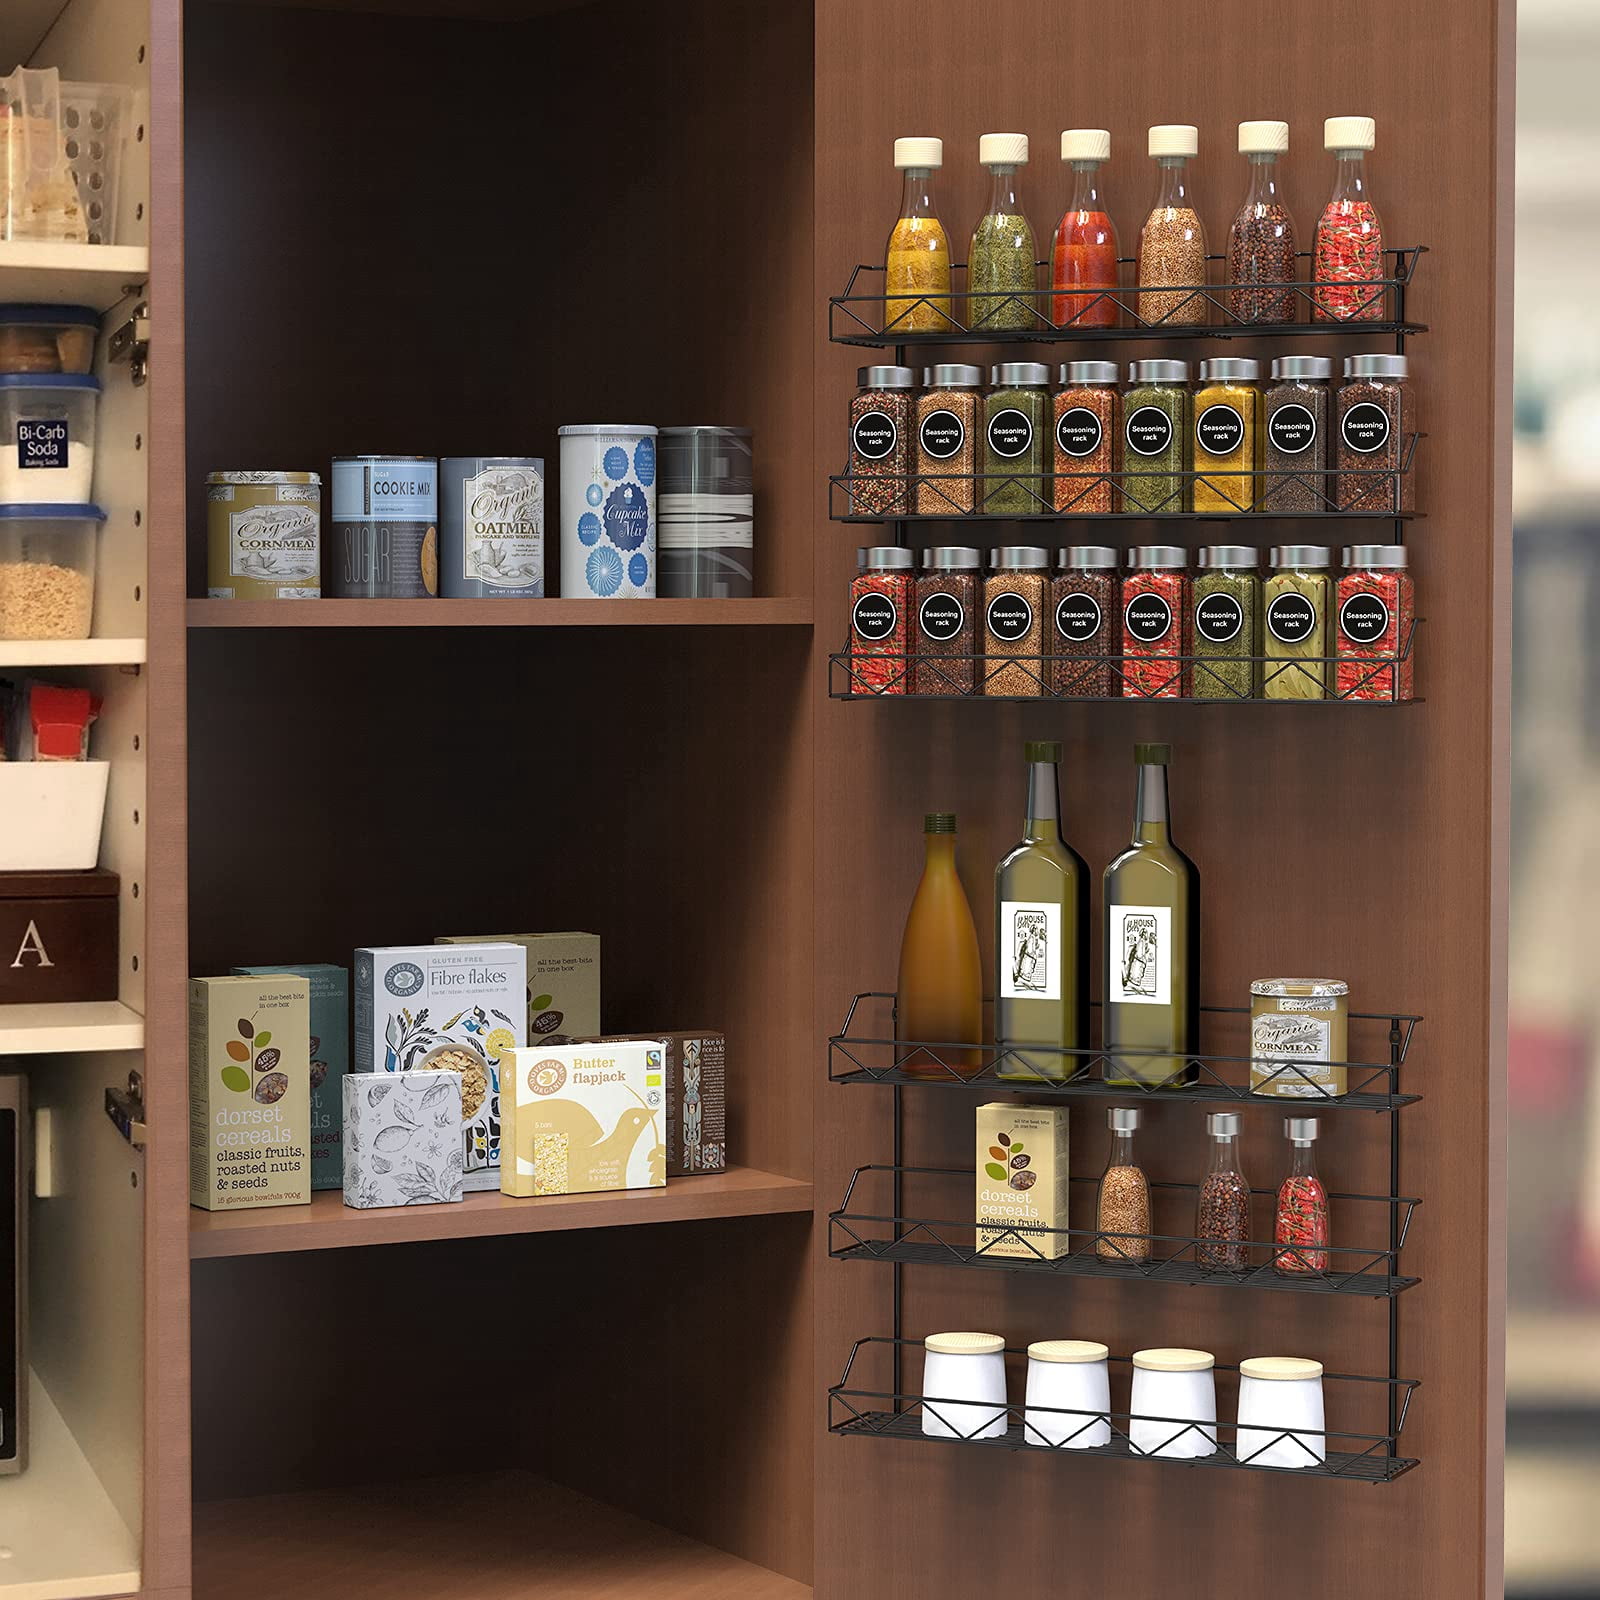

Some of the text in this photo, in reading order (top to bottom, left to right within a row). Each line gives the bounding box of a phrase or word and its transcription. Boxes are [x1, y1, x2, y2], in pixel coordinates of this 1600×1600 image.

[1062, 426, 1096, 434] Seasoning
[1132, 425, 1166, 433] Seasoning
[1203, 424, 1238, 433] Seasoning
[1275, 423, 1310, 431] Seasoning
[1348, 422, 1384, 430] Seasoning
[19, 424, 65, 440] Bi-Carb
[859, 429, 891, 438] Seasoning
[926, 428, 958, 437] Seasoning
[994, 427, 1026, 436] Seasoning
[1214, 432, 1229, 440] rack
[1286, 431, 1301, 439] rack
[1359, 430, 1374, 438] rack
[869, 437, 882, 445] rack
[936, 436, 950, 444] rack
[1073, 434, 1087, 442] rack
[1143, 433, 1158, 441] rack
[27, 440, 58, 456] Soda
[374, 481, 431, 496] COOKIE MIX
[471, 481, 539, 520] Organic
[606, 504, 646, 523] Cupcake
[237, 514, 312, 538] Organic
[474, 522, 540, 534] OATMEAL
[620, 520, 642, 537] Mix
[239, 540, 316, 549] CORNMEAL
[344, 527, 390, 582] SUGAR
[858, 611, 890, 619] Seasoning
[925, 611, 958, 619] Seasoning
[993, 611, 1026, 619] Seasoning
[1061, 611, 1095, 620] Seasoning
[1131, 612, 1166, 620] Seasoning
[1201, 612, 1236, 620] Seasoning
[1273, 612, 1309, 620] Seasoning
[1346, 612, 1382, 620] Seasoning
[1072, 619, 1086, 627] rack
[1142, 620, 1156, 628] rack
[1213, 620, 1227, 628] rack
[1285, 620, 1299, 628] rack
[1358, 620, 1372, 628] rack
[1024, 915, 1044, 923] HOUSE
[1133, 919, 1154, 928] HOUSE
[10, 919, 55, 968] A
[431, 968, 507, 986] Fibre flakes
[387, 983, 421, 996] ORGANIC
[1254, 1022, 1317, 1041] Organic
[702, 1038, 715, 1046] Rice
[1255, 1042, 1321, 1051] CORNMEAL
[573, 1058, 615, 1069] Butter
[573, 1070, 626, 1086] flapjack
[216, 1106, 283, 1126] dorset
[216, 1126, 292, 1146] cereals
[217, 1146, 305, 1162] classic fruits,
[217, 1161, 301, 1176] roasted nuts
[217, 1176, 268, 1190] & seeds
[226, 1195, 254, 1204] glorious
[284, 1192, 301, 1200] 700g
[980, 1189, 1032, 1204] dorset
[980, 1204, 1039, 1218] cereals
[981, 1217, 1049, 1228] classic fruits,
